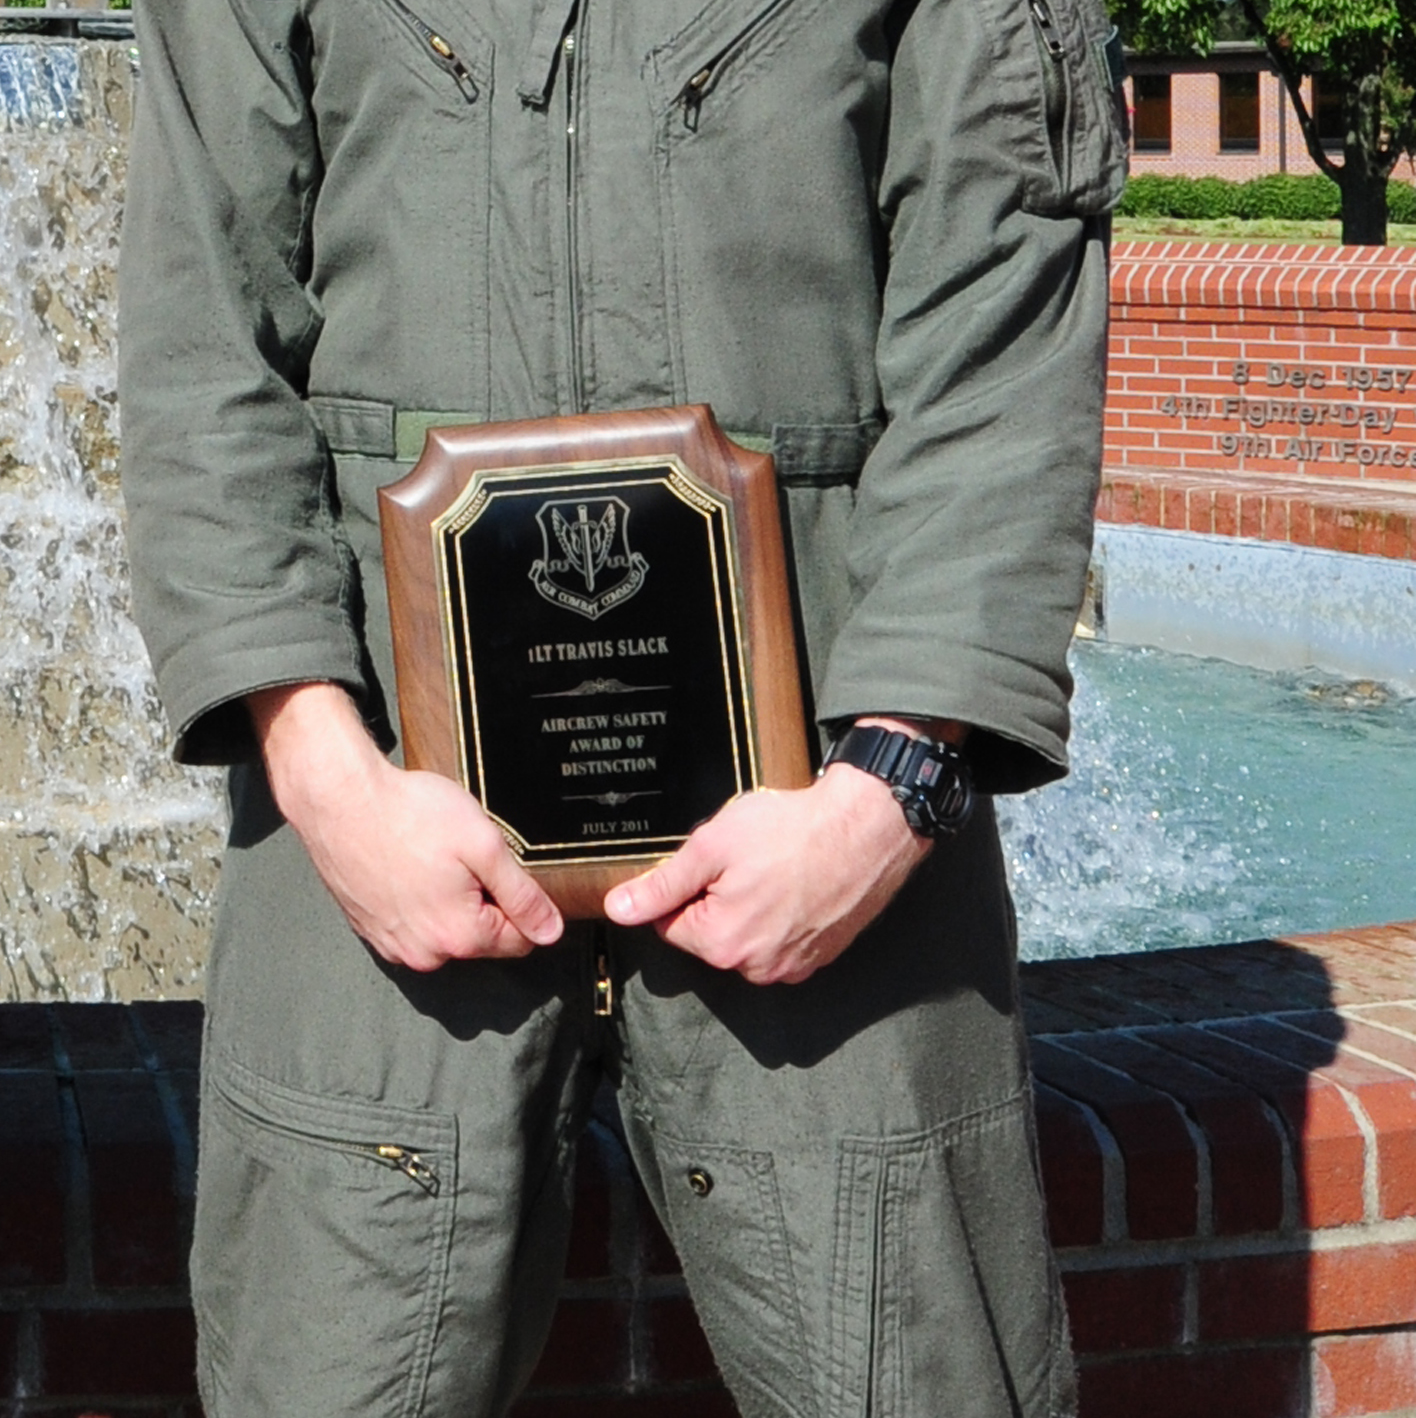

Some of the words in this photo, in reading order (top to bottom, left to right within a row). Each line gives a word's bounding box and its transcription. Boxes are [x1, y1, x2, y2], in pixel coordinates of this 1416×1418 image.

[1232, 361, 1250, 385] 8
[1266, 362, 1325, 389] Dec
[1342, 366, 1412, 393] 1957
[1161, 394, 1211, 420] 4th
[1223, 396, 1396, 434] Fighter-Day
[1222, 433, 1271, 458] 9th
[1284, 438, 1323, 462] Air
[528, 644, 553, 663] 1LT
[555, 640, 613, 661] TRAVIS
[617, 636, 669, 657] SLACK
[541, 714, 610, 733] AIRCREW
[612, 710, 667, 728] SAFETY
[569, 736, 622, 753] AWARD
[626, 734, 645, 749] OF
[561, 756, 657, 777] DISTINCTION
[582, 822, 617, 835] JULY
[620, 819, 649, 833] 2011
